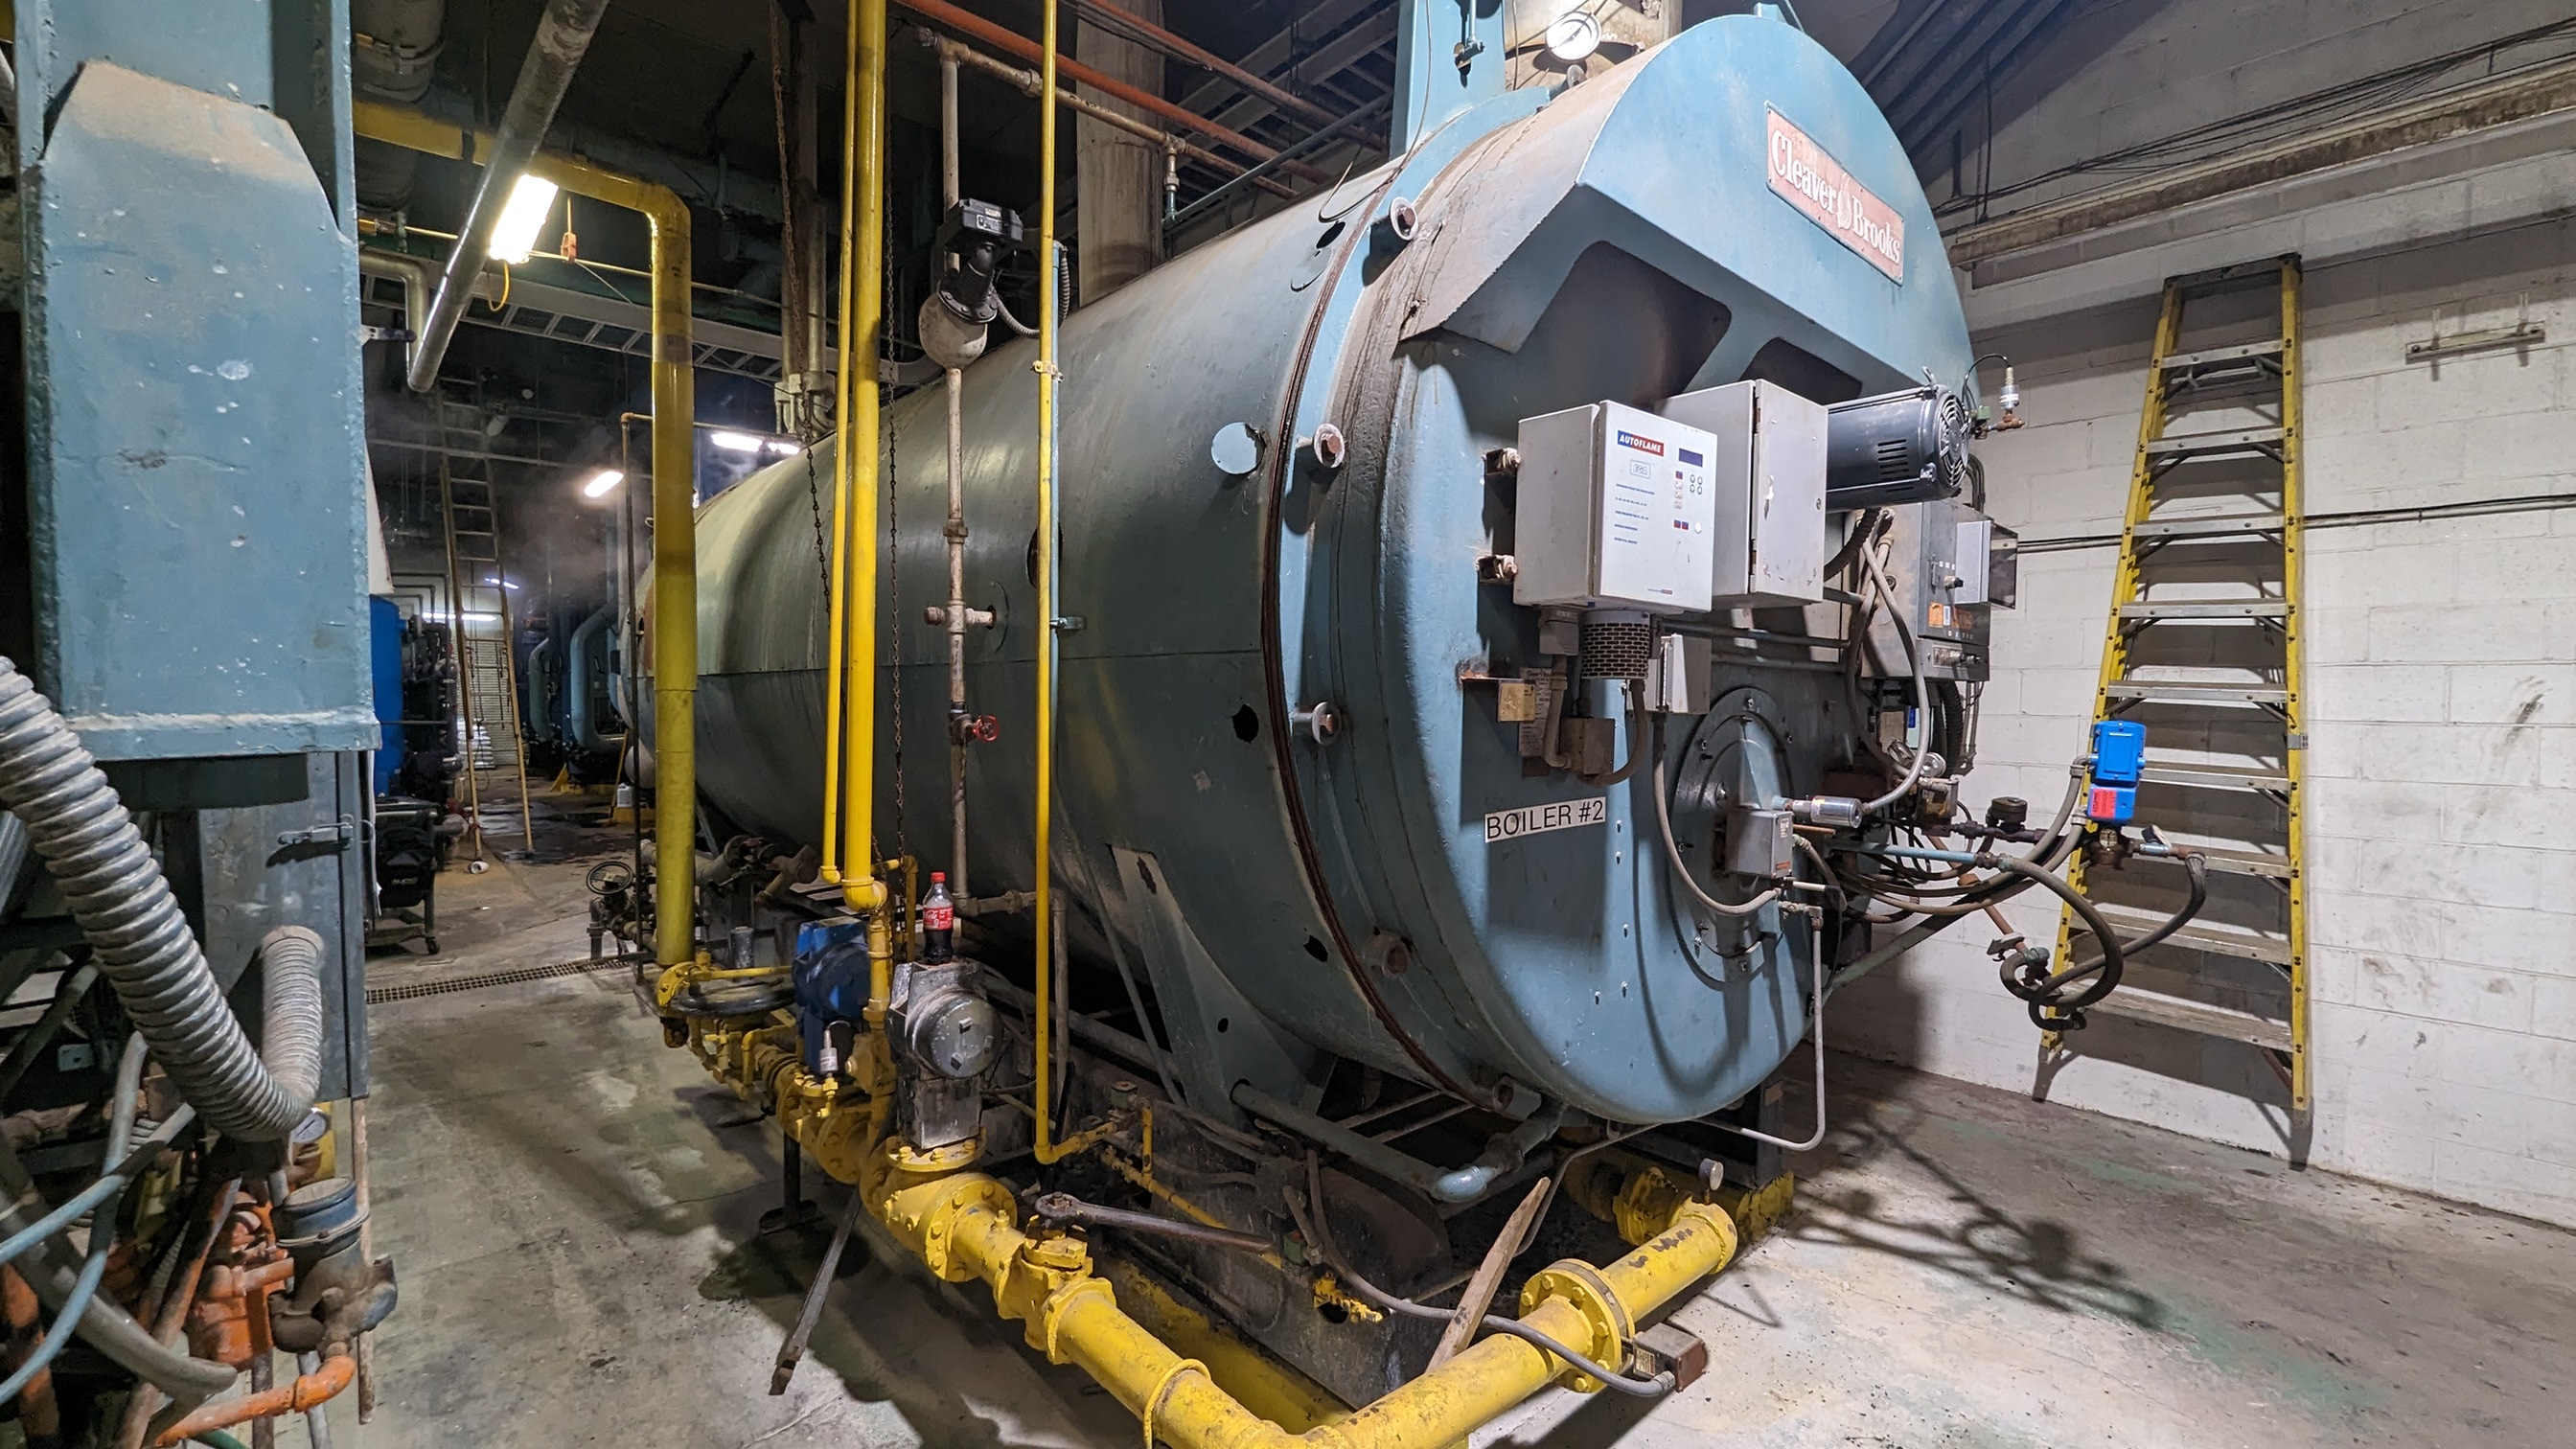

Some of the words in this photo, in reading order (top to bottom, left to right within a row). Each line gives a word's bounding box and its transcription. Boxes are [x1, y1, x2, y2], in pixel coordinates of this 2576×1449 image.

[1772, 129, 1837, 215] Cleaver
[1852, 195, 1900, 264] Brooks
[1619, 433, 1662, 453] AUTOFLAME
[1486, 804, 1572, 840] BOILER
[1578, 800, 1604, 823] #2
